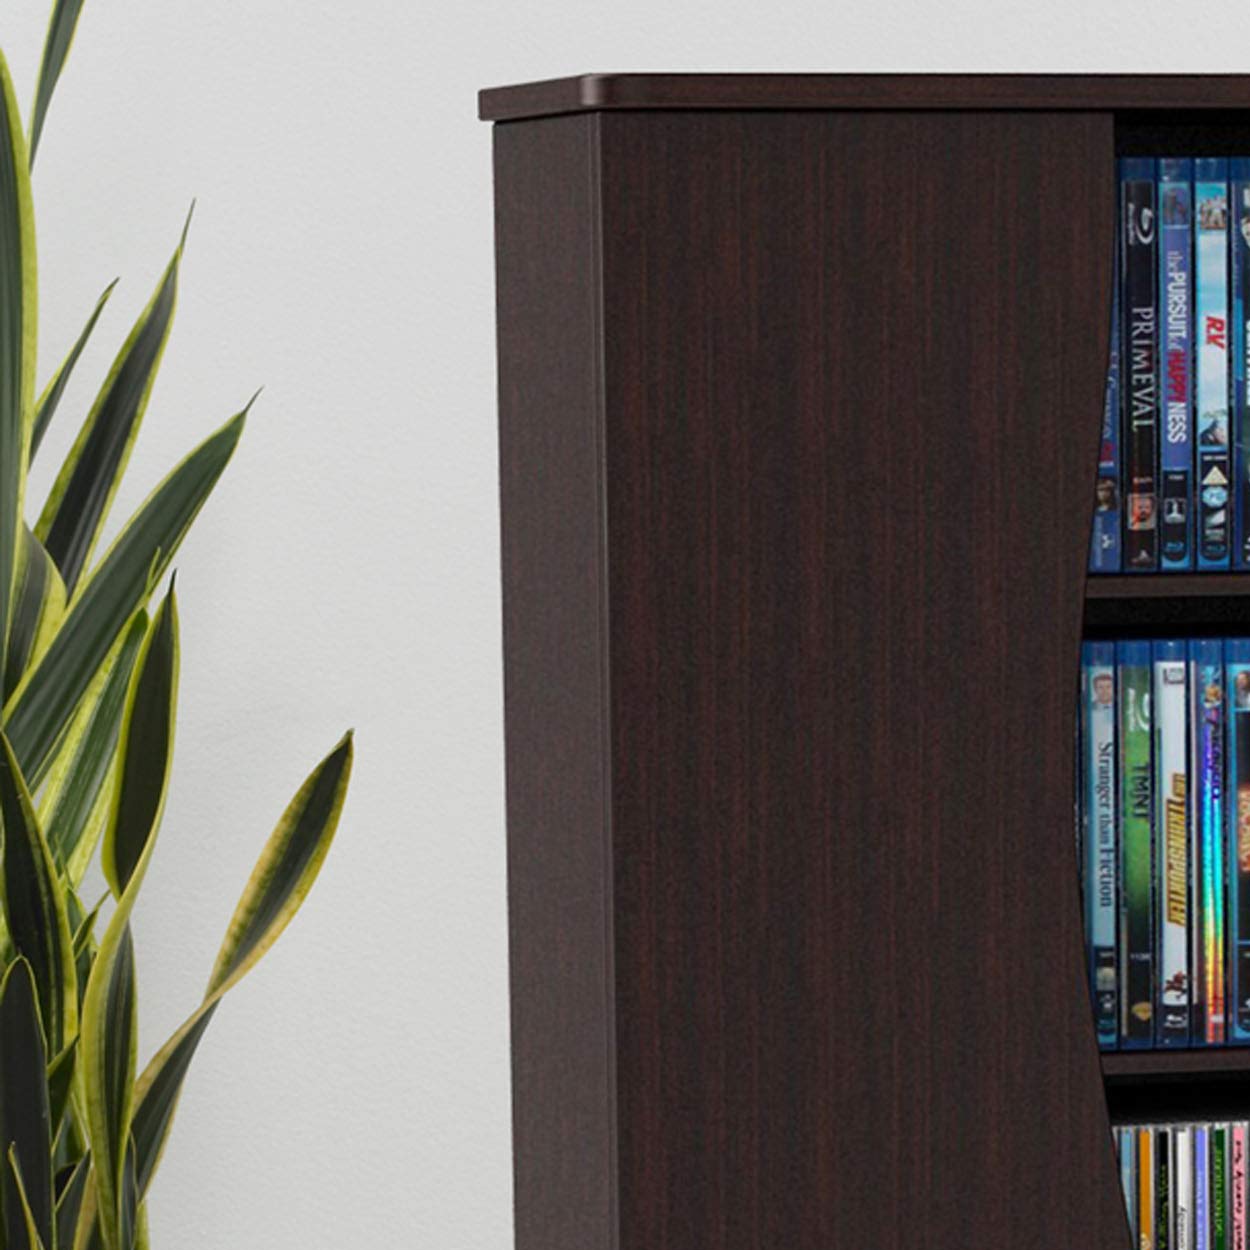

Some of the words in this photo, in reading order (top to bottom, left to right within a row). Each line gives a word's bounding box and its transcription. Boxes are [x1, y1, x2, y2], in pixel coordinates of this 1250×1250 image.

[1167, 271, 1187, 338] PURSUIT
[1132, 308, 1155, 432] PRIMEVAL
[1095, 741, 1113, 808] Stranger
[1131, 764, 1151, 818] TMNT
[1098, 814, 1113, 845] than
[1165, 798, 1186, 927] TRANSPORTER
[1098, 847, 1114, 908] Fiction
